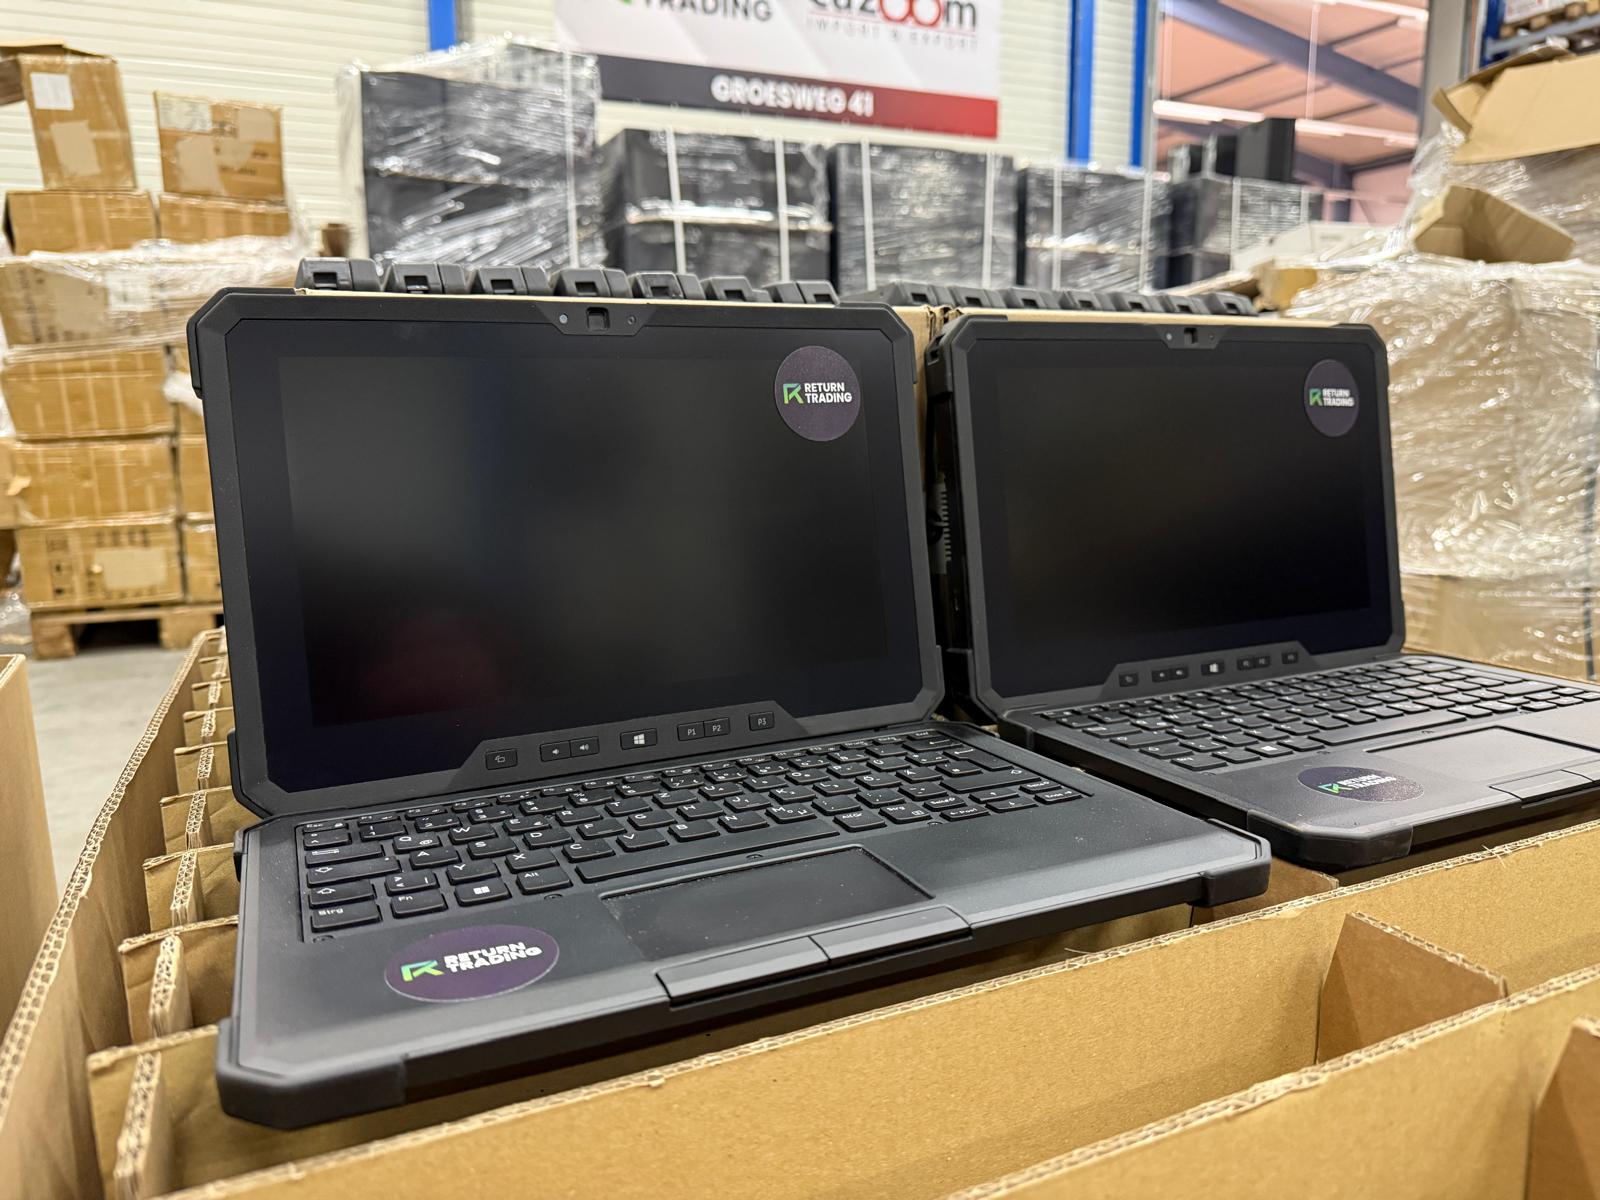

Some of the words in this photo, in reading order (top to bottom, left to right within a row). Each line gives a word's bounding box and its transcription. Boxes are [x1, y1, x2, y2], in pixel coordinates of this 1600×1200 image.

[848, 89, 874, 118] 41
[804, 382, 845, 393] RETURN
[804, 392, 853, 404] TRADING
[1323, 397, 1355, 407] TRADING
[757, 717, 767, 726] P3
[687, 728, 696, 736] P1
[712, 724, 722, 732] P2
[318, 908, 344, 916] Strg
[444, 942, 527, 967] RETURN
[445, 946, 543, 973] TRADING
